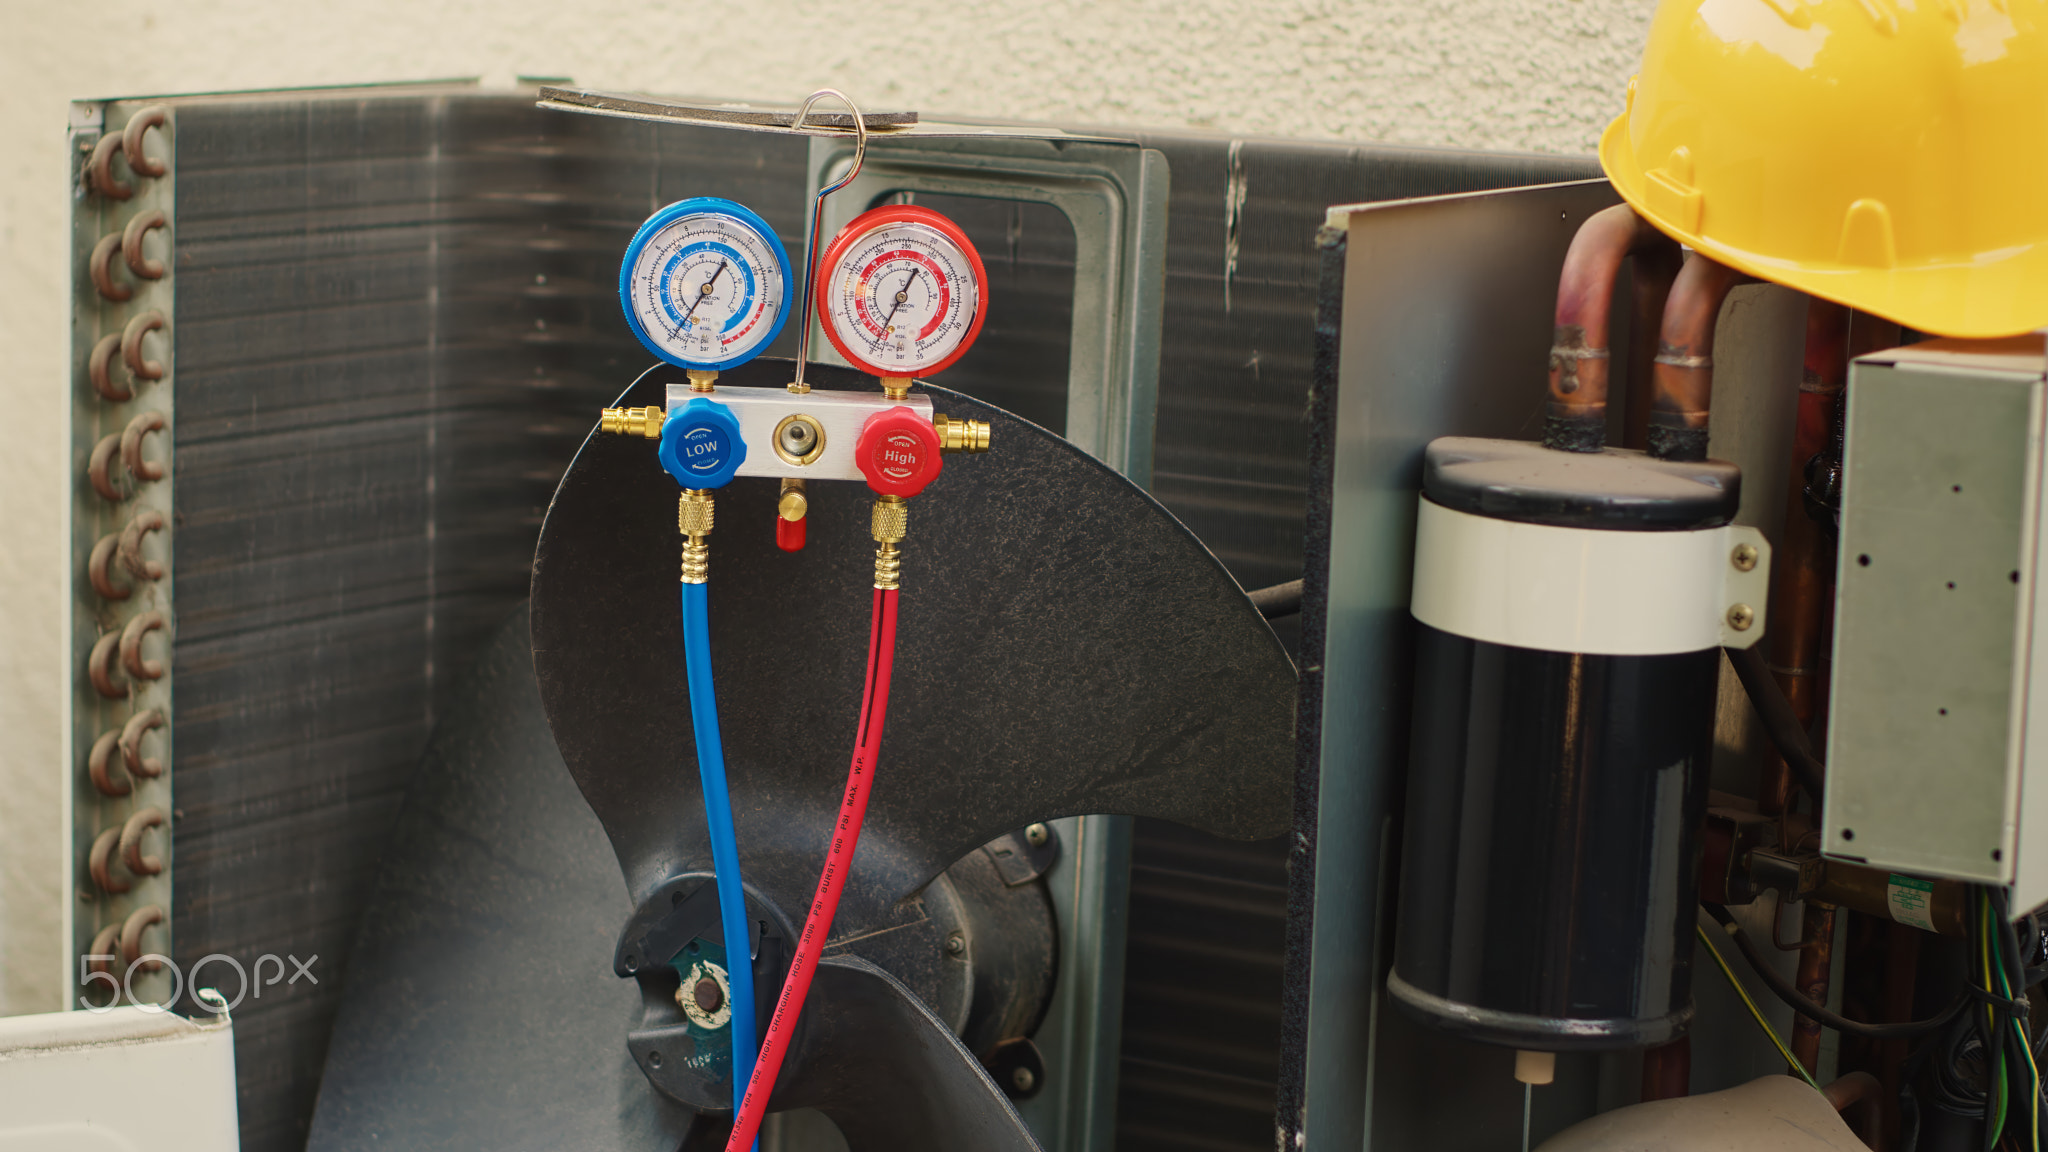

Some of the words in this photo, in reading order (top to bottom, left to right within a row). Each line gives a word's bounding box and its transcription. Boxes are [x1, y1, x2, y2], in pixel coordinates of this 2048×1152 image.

[672, 244, 682, 252] 100
[926, 251, 937, 260] 300
[844, 261, 850, 269] 10
[960, 275, 968, 284] 25
[954, 322, 962, 330] 30
[686, 441, 717, 457] LOW
[884, 450, 916, 464] High
[752, 1069, 761, 1084] 502
[760, 1040, 773, 1062] HIGH
[771, 985, 793, 1032] CHARGING
[792, 952, 805, 977] HOSE
[803, 923, 815, 944] 3000
[813, 901, 823, 916] PSI
[821, 861, 836, 893] BURST
[834, 838, 843, 854] 600
[840, 815, 850, 830] PSI
[847, 784, 858, 806] MAX.
